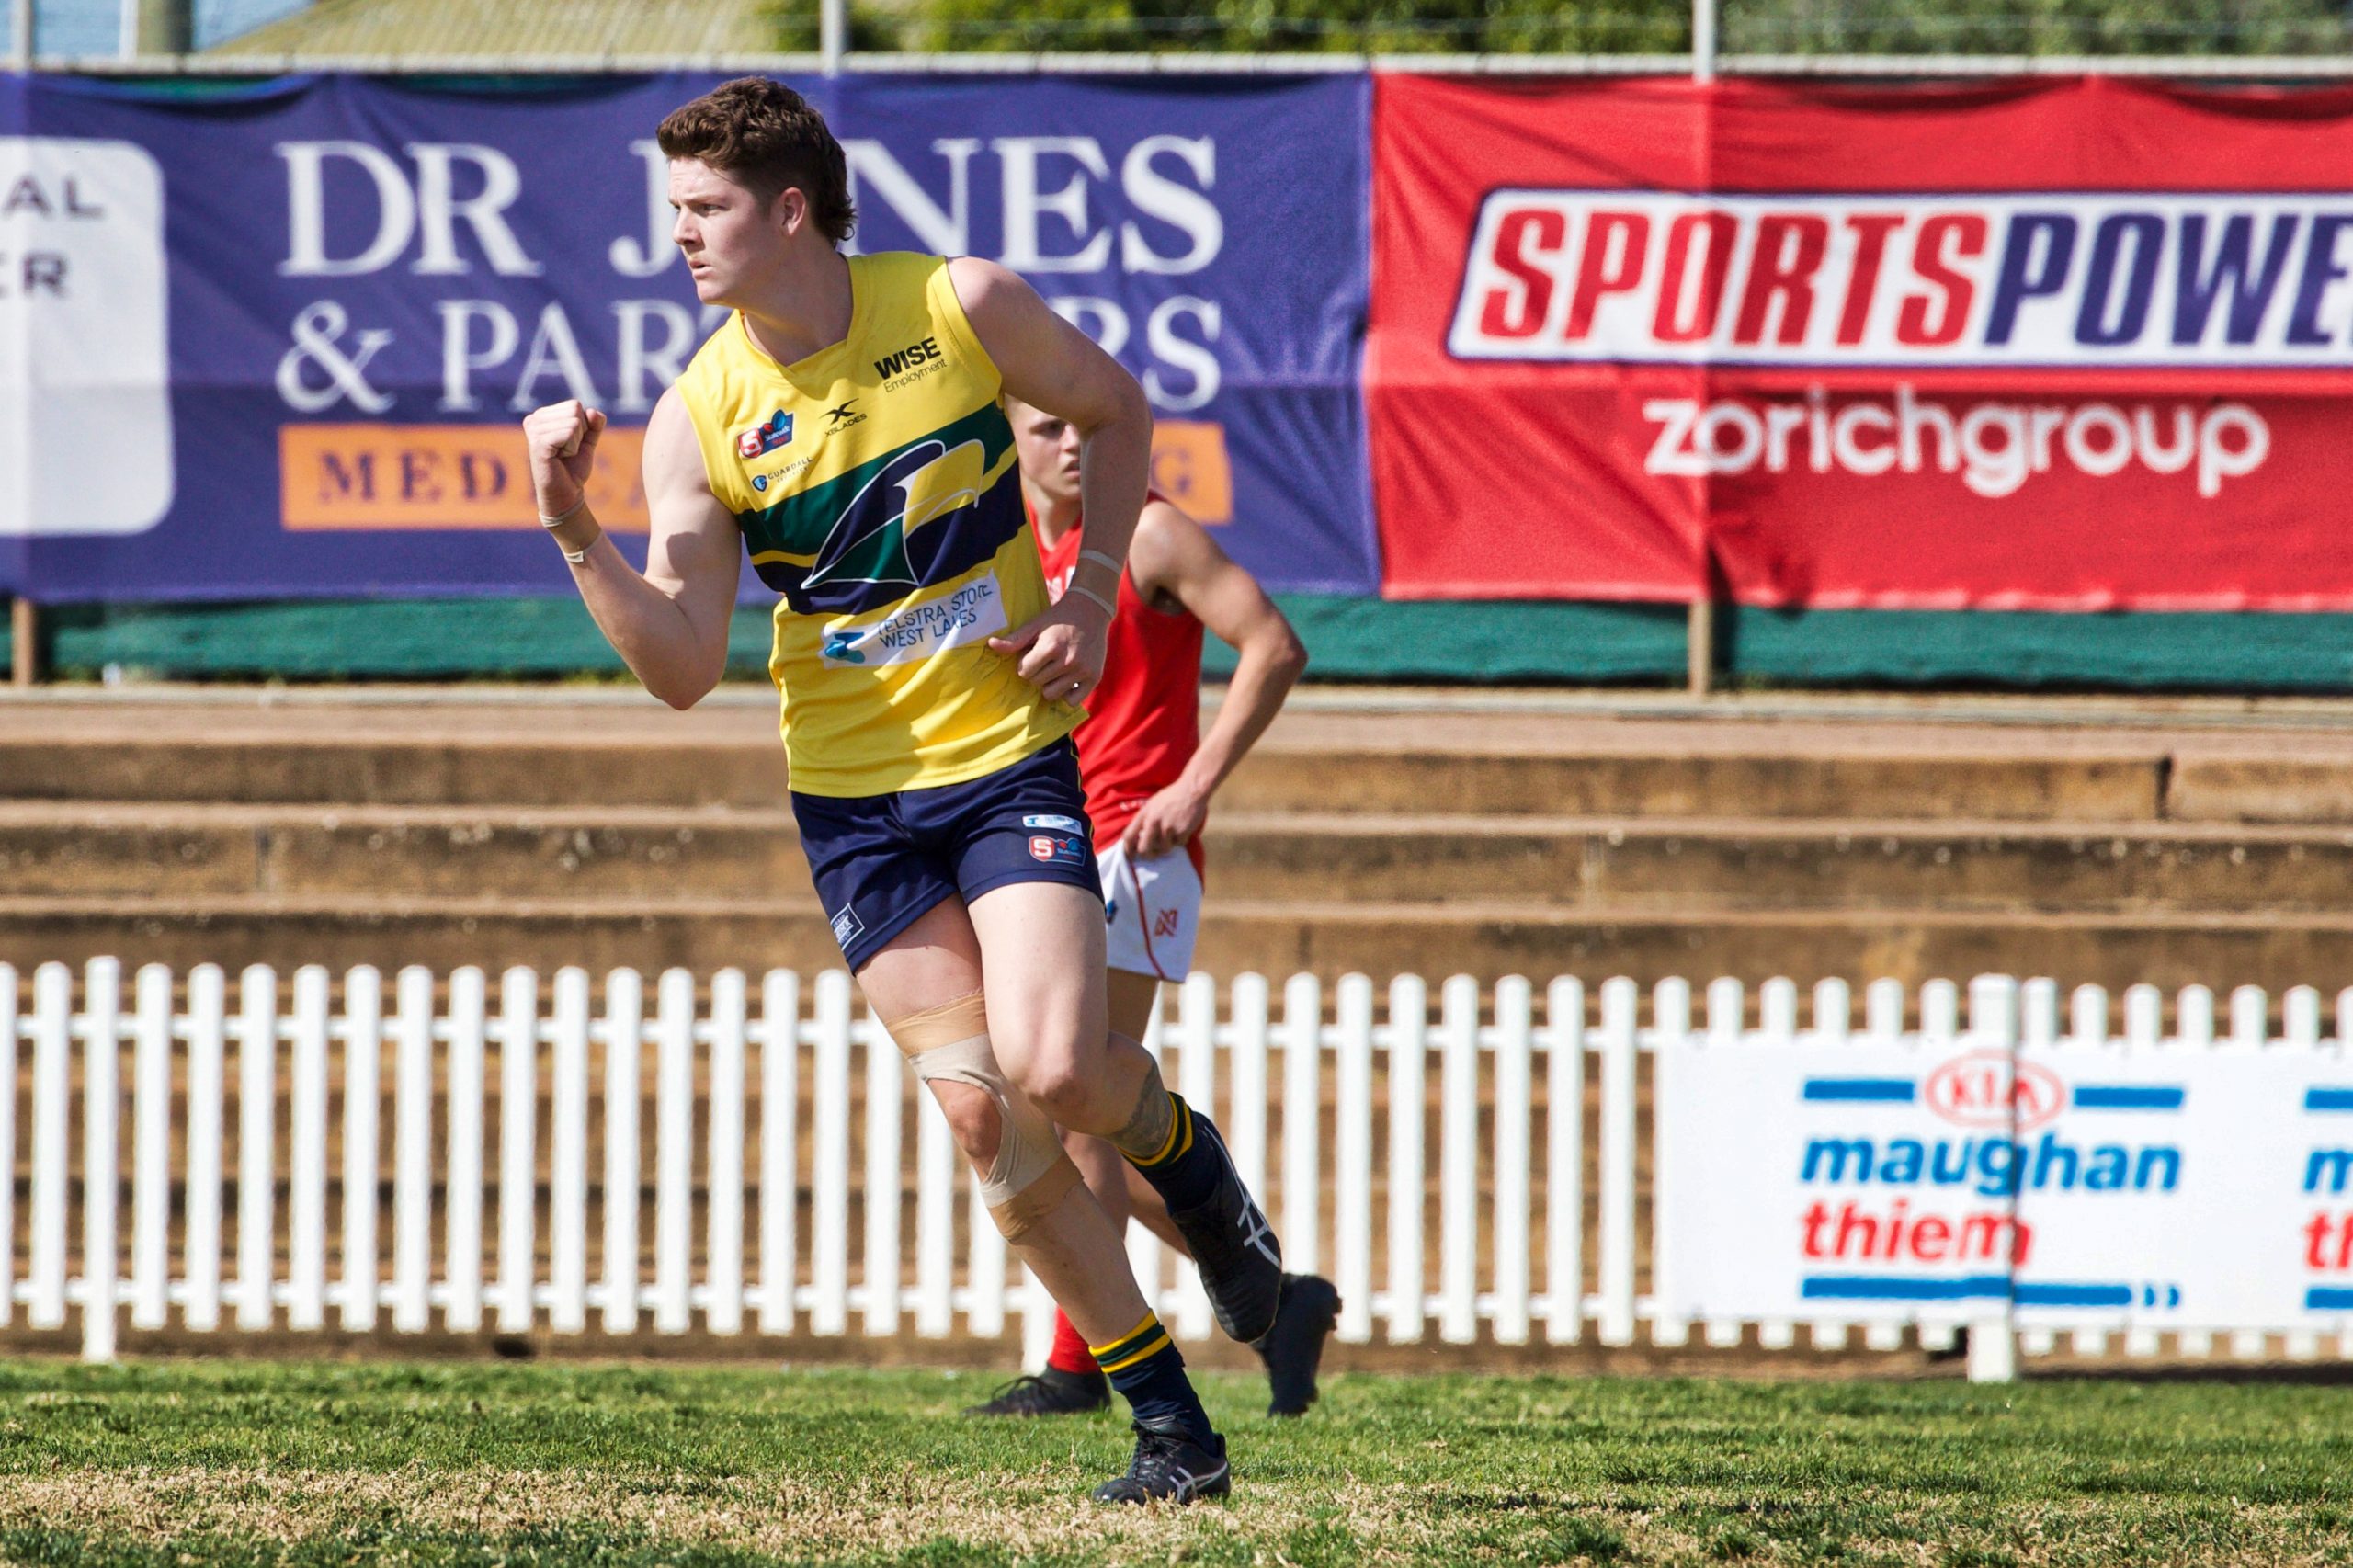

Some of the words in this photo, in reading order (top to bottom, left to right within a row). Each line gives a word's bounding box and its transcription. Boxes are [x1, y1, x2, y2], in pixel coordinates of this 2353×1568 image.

[277, 140, 542, 278] DR
[609, 134, 1223, 278] JNES
[277, 299, 396, 414] &
[873, 336, 942, 380] WISE
[883, 358, 948, 393] Employment
[767, 456, 813, 480] GUARDALL
[1643, 382, 2271, 499] zorichgroup
[879, 628, 925, 649] WEST
[1800, 1131, 2182, 1198] maughan
[1799, 1198, 2033, 1267] thiem
